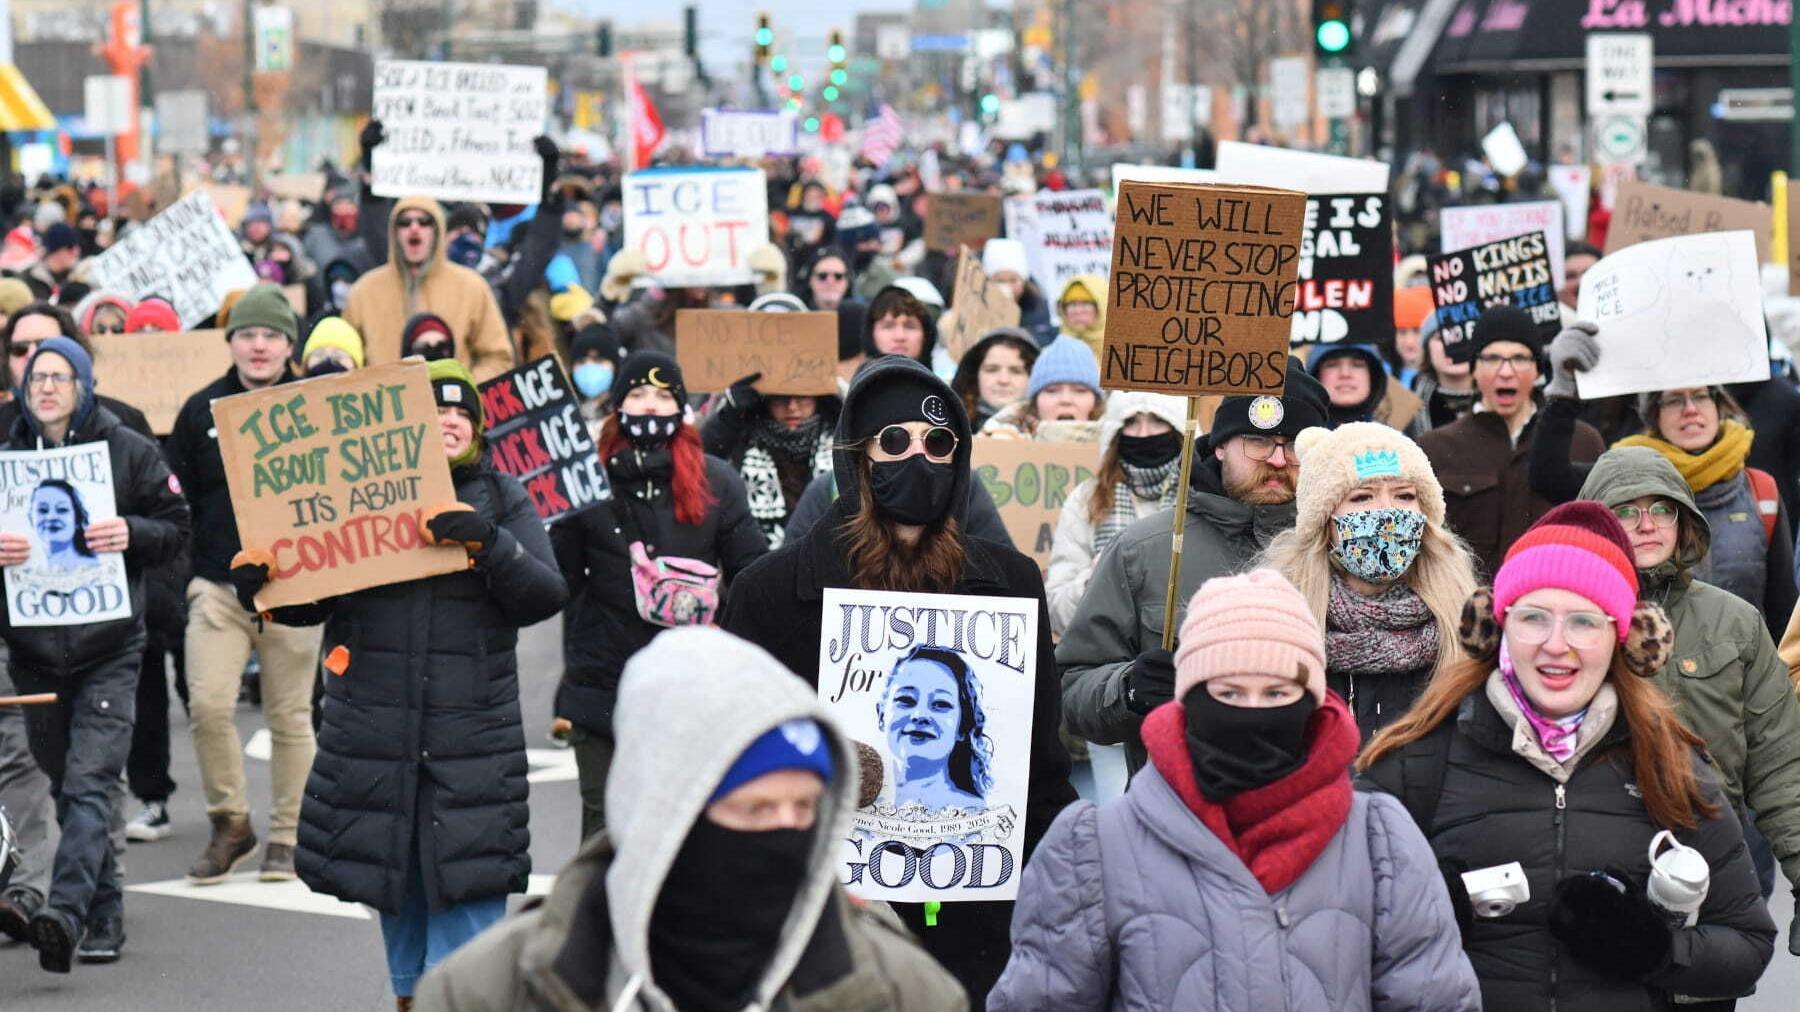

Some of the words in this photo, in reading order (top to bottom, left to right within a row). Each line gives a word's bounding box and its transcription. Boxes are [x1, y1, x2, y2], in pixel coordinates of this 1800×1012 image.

[632, 179, 749, 217] ICE
[1125, 192, 1174, 226] WE
[1196, 196, 1283, 236] WILL
[1329, 196, 1382, 229] IS
[1623, 195, 1692, 233] Raised
[639, 219, 751, 273] OUT
[1119, 235, 1217, 273] NEVER
[1224, 241, 1298, 277] STOP
[1432, 256, 1464, 284] NO
[1471, 233, 1545, 273] KINGS
[1116, 271, 1296, 319] PROTECTING
[1436, 280, 1468, 307] NO
[1476, 258, 1550, 300] NAZIS
[1513, 283, 1552, 309] ICE
[695, 313, 730, 346] NO
[743, 315, 795, 346] ICE
[1161, 316, 1225, 347] OUR
[1290, 308, 1349, 343] ND
[1596, 299, 1625, 320] ICE
[1106, 342, 1286, 390] NEIGHBORS
[326, 383, 407, 437] ISN'T
[480, 379, 526, 429] UCK
[513, 358, 565, 411] ICE
[252, 446, 330, 498] ABOUT
[340, 423, 427, 484] SAFETY
[490, 427, 551, 477] UCK
[540, 403, 592, 462] ICE
[0, 450, 106, 492] JUSTICE
[527, 472, 571, 518] CK
[560, 452, 613, 509] ICE
[5, 487, 28, 514] for
[288, 491, 337, 528] IT'S
[349, 475, 422, 513] ABOUT
[15, 583, 124, 618] GOOD
[828, 603, 1028, 675] JUSTICE
[830, 652, 884, 704] for
[877, 820, 906, 833] Nicole
